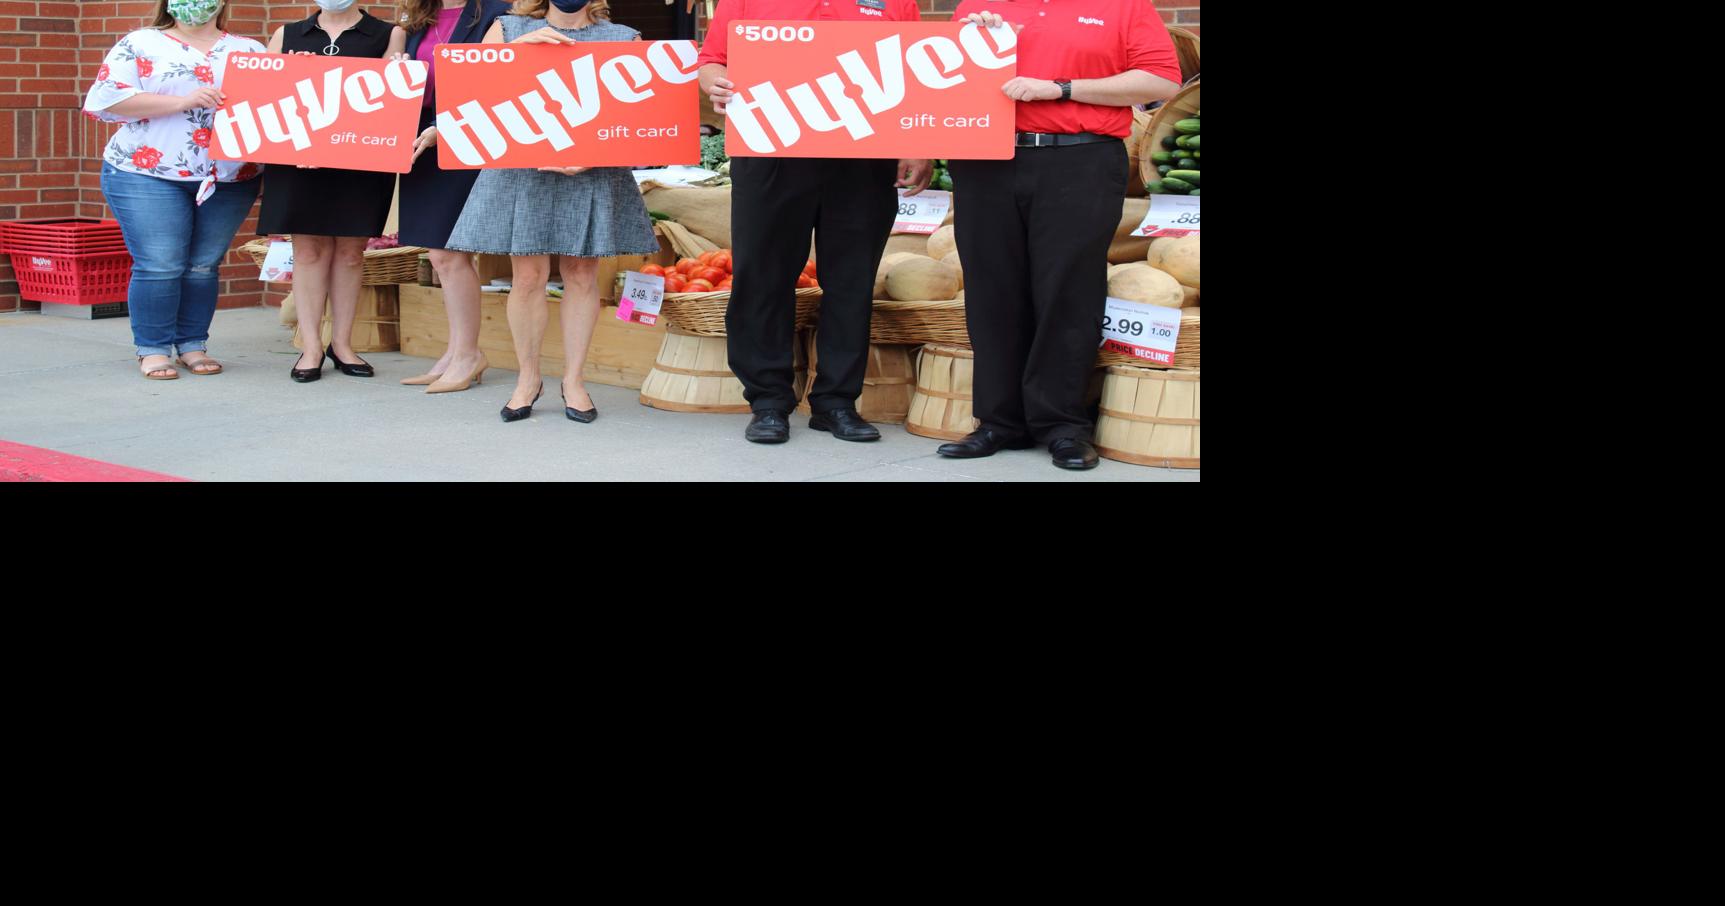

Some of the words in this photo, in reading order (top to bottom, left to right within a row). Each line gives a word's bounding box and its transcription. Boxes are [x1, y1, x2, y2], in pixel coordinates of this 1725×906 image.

[735, 24, 815, 42] $5000
[231, 56, 284, 71] $5000
[440, 48, 515, 64] $5000
[726, 21, 1017, 153] HyVee
[214, 60, 427, 159] HyVee
[437, 40, 699, 166] HyVee
[900, 114, 936, 129] gift
[943, 114, 990, 128] card
[330, 132, 357, 144] gift
[362, 136, 397, 146] card
[597, 126, 630, 140] gift
[636, 125, 678, 137] card
[1151, 327, 1171, 337] 1.00
[1111, 342, 1133, 355] PRICE
[1134, 348, 1170, 363] DECLINE
